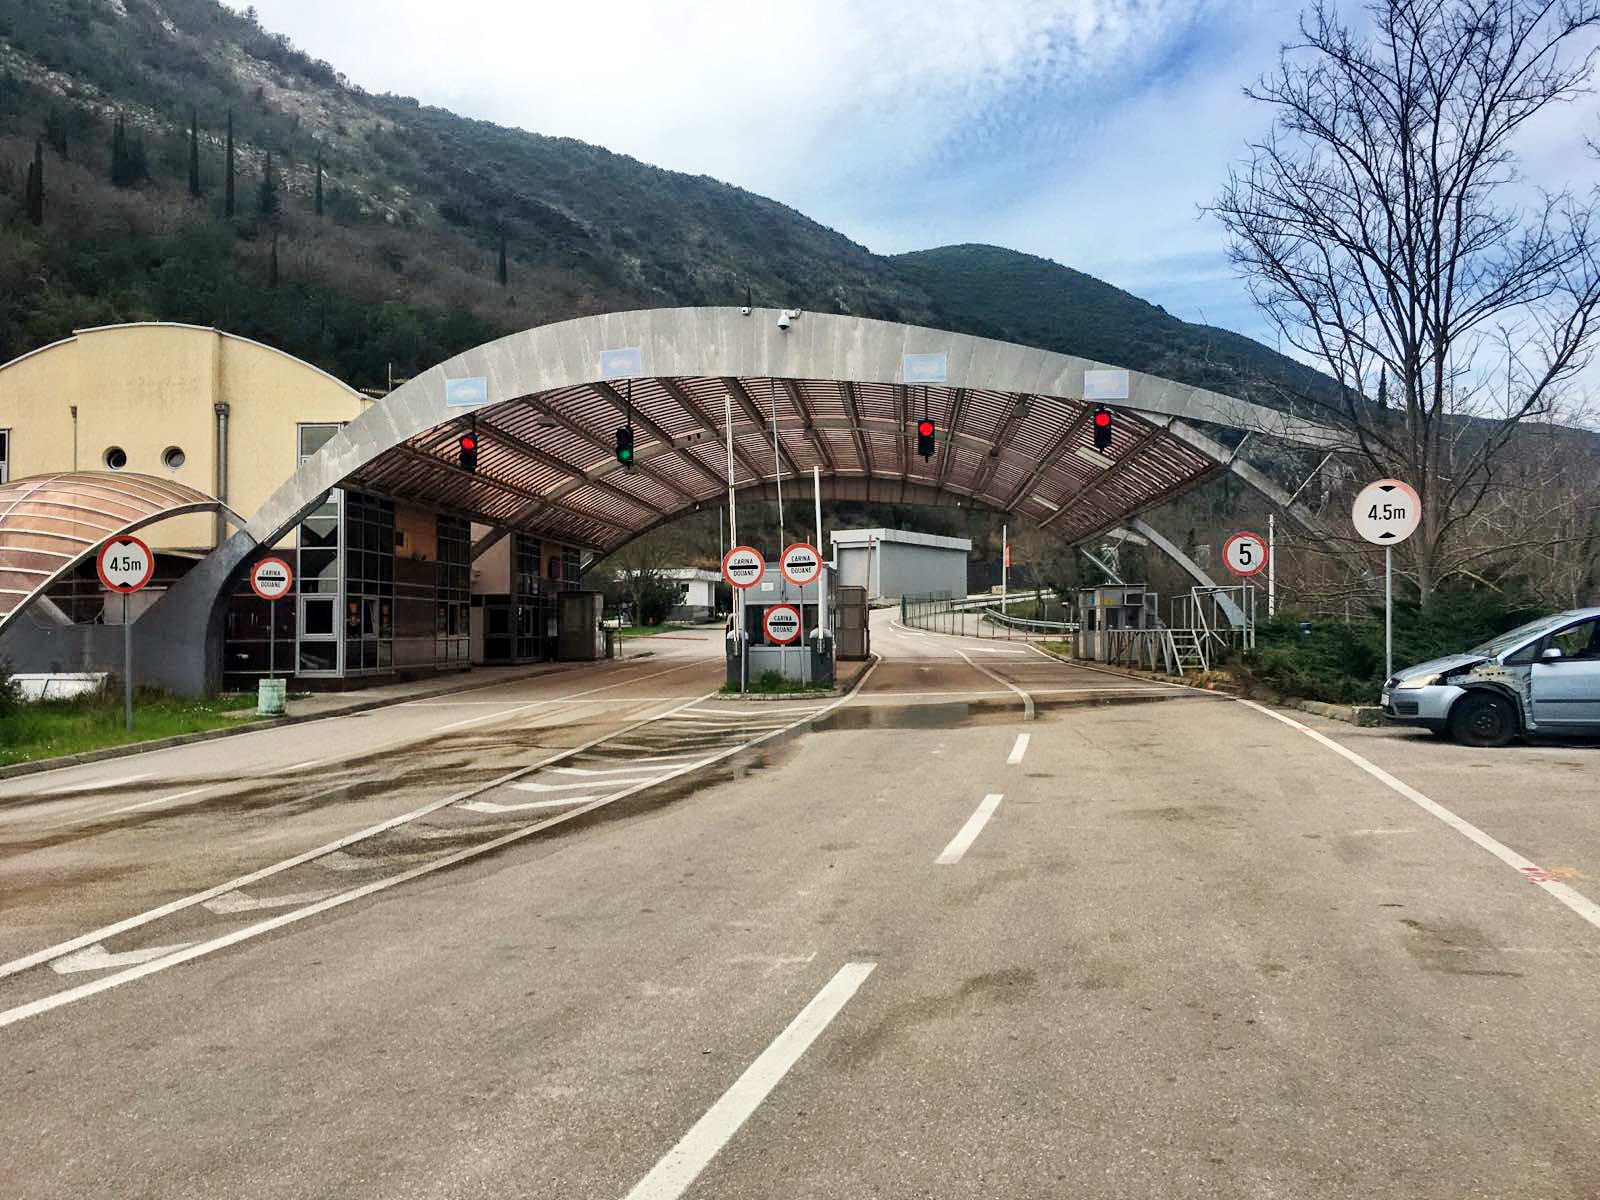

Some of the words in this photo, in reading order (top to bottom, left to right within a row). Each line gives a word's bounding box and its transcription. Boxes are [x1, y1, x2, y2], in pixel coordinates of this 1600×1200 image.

[1368, 504, 1405, 520] 4.5m
[1239, 543, 1252, 565] 5
[109, 556, 142, 572] 4.5m
